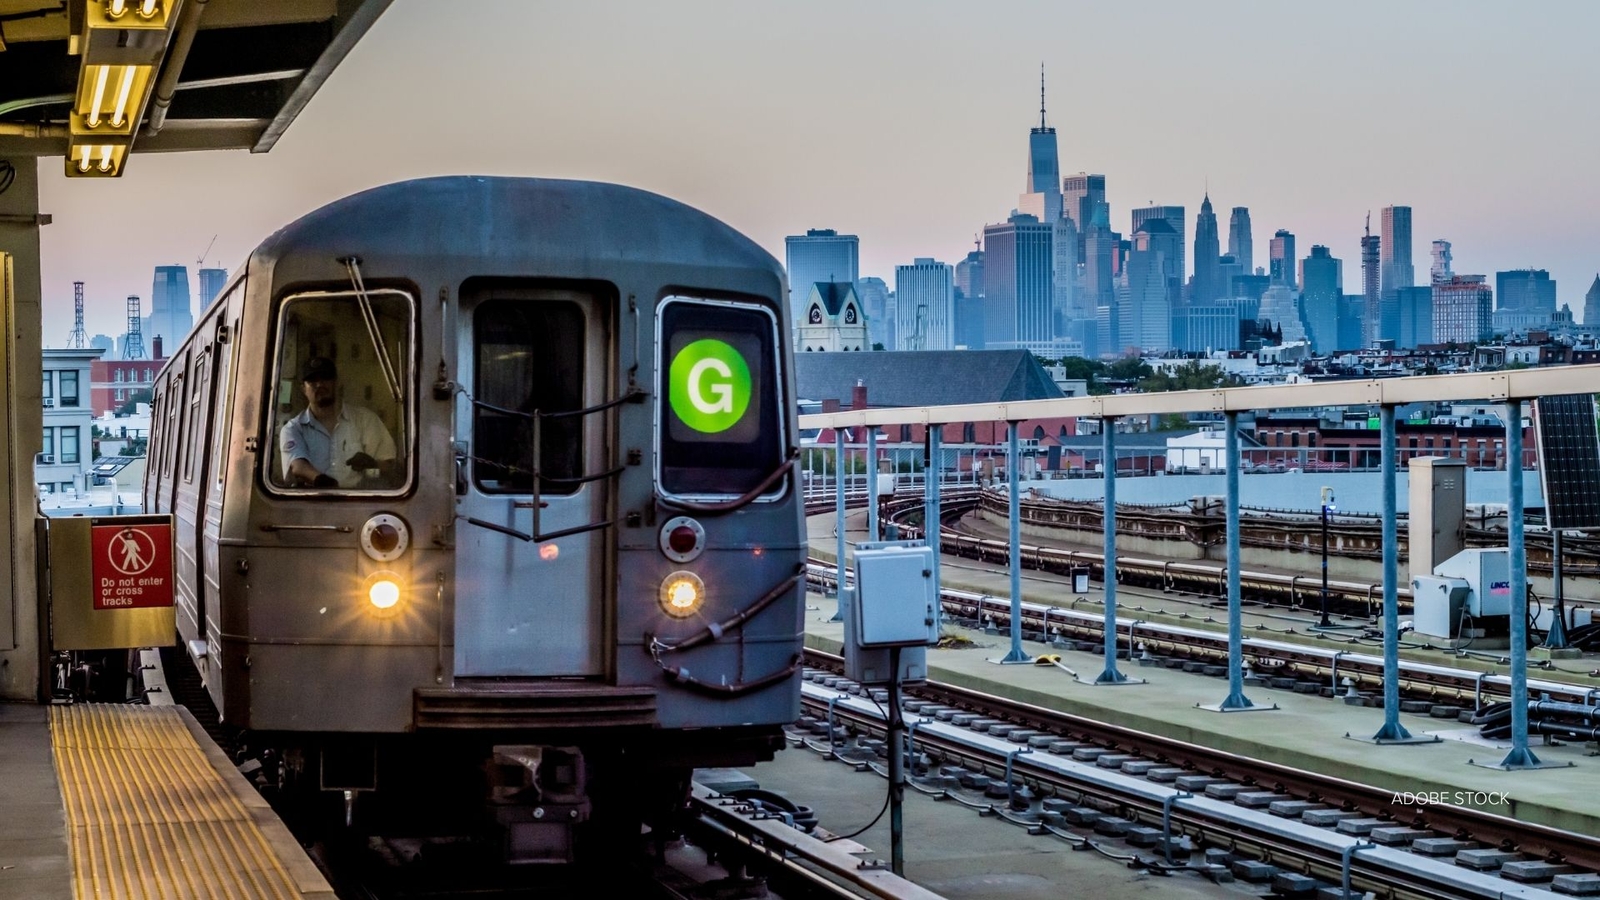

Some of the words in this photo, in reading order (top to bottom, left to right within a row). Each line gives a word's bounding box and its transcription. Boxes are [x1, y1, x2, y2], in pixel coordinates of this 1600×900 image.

[687, 357, 733, 414] G
[101, 577, 115, 587] Do
[119, 577, 135, 586] not
[138, 576, 164, 586] enter
[101, 588, 113, 596] or
[115, 587, 143, 595] cross
[102, 596, 133, 606] tracks
